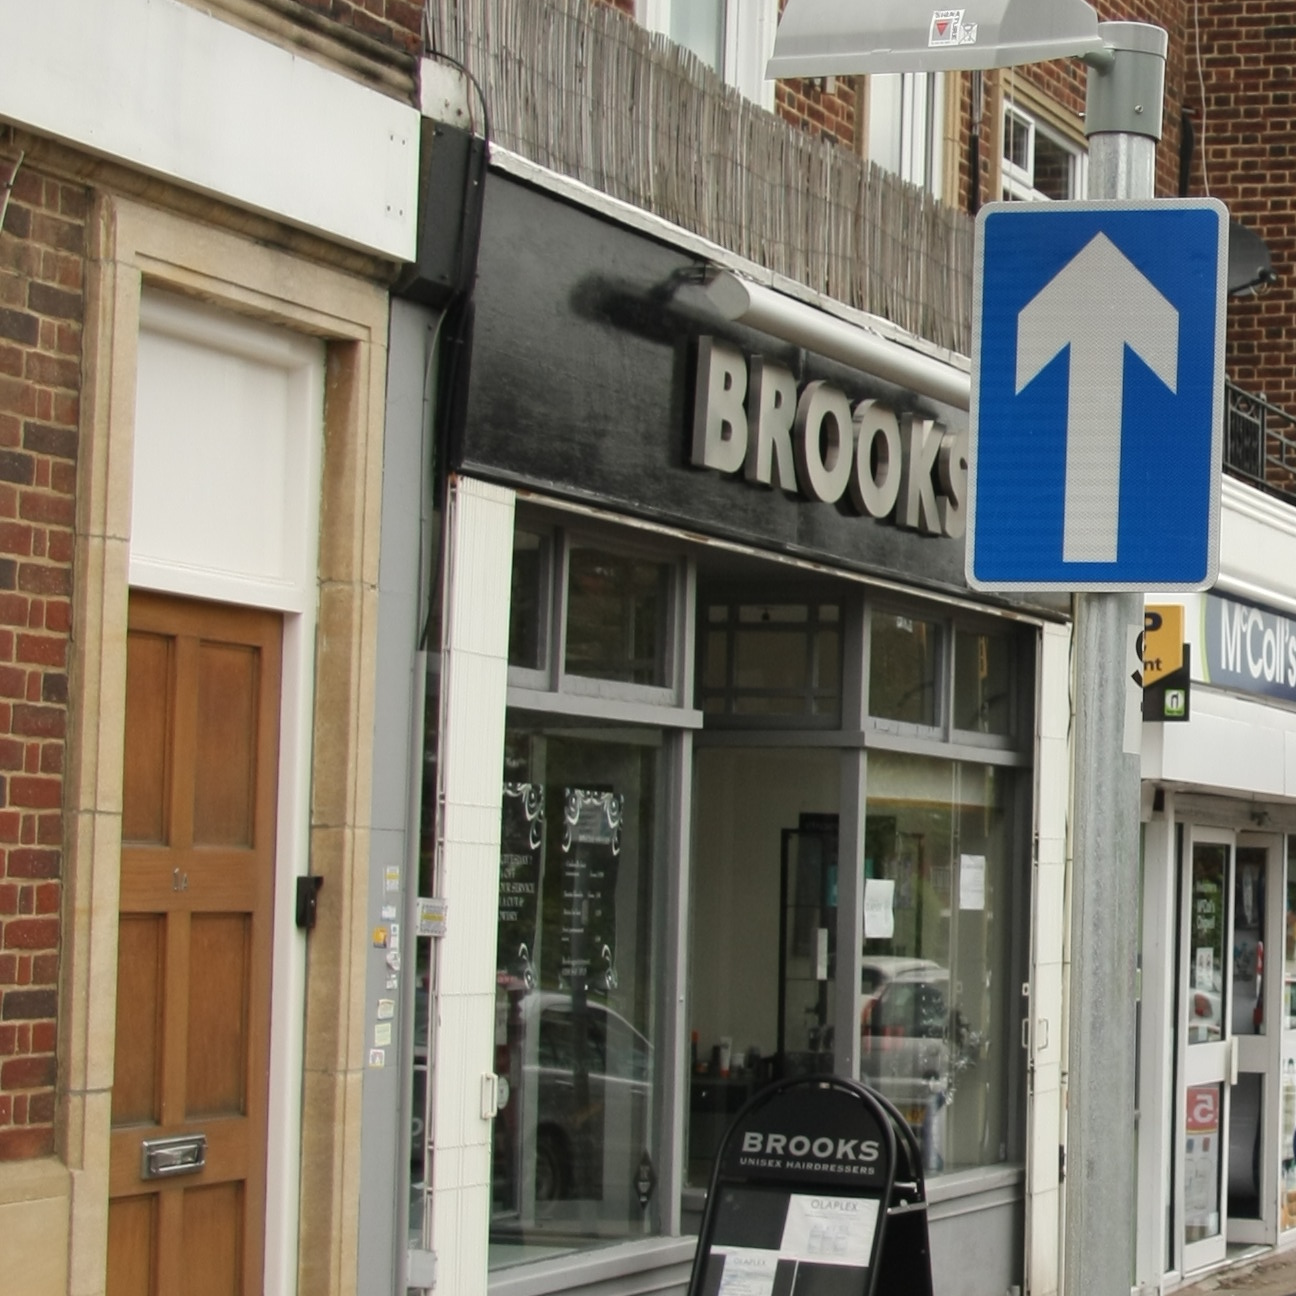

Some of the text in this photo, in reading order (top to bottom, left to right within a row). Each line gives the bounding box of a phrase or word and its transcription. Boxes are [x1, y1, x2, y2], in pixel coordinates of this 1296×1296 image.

[691, 335, 968, 539] BROOKS
[742, 1131, 880, 1162] BROOKS
[740, 1157, 875, 1175] UNISEX HAIRDRESSERS
[811, 1199, 858, 1211] OLAPLEX
